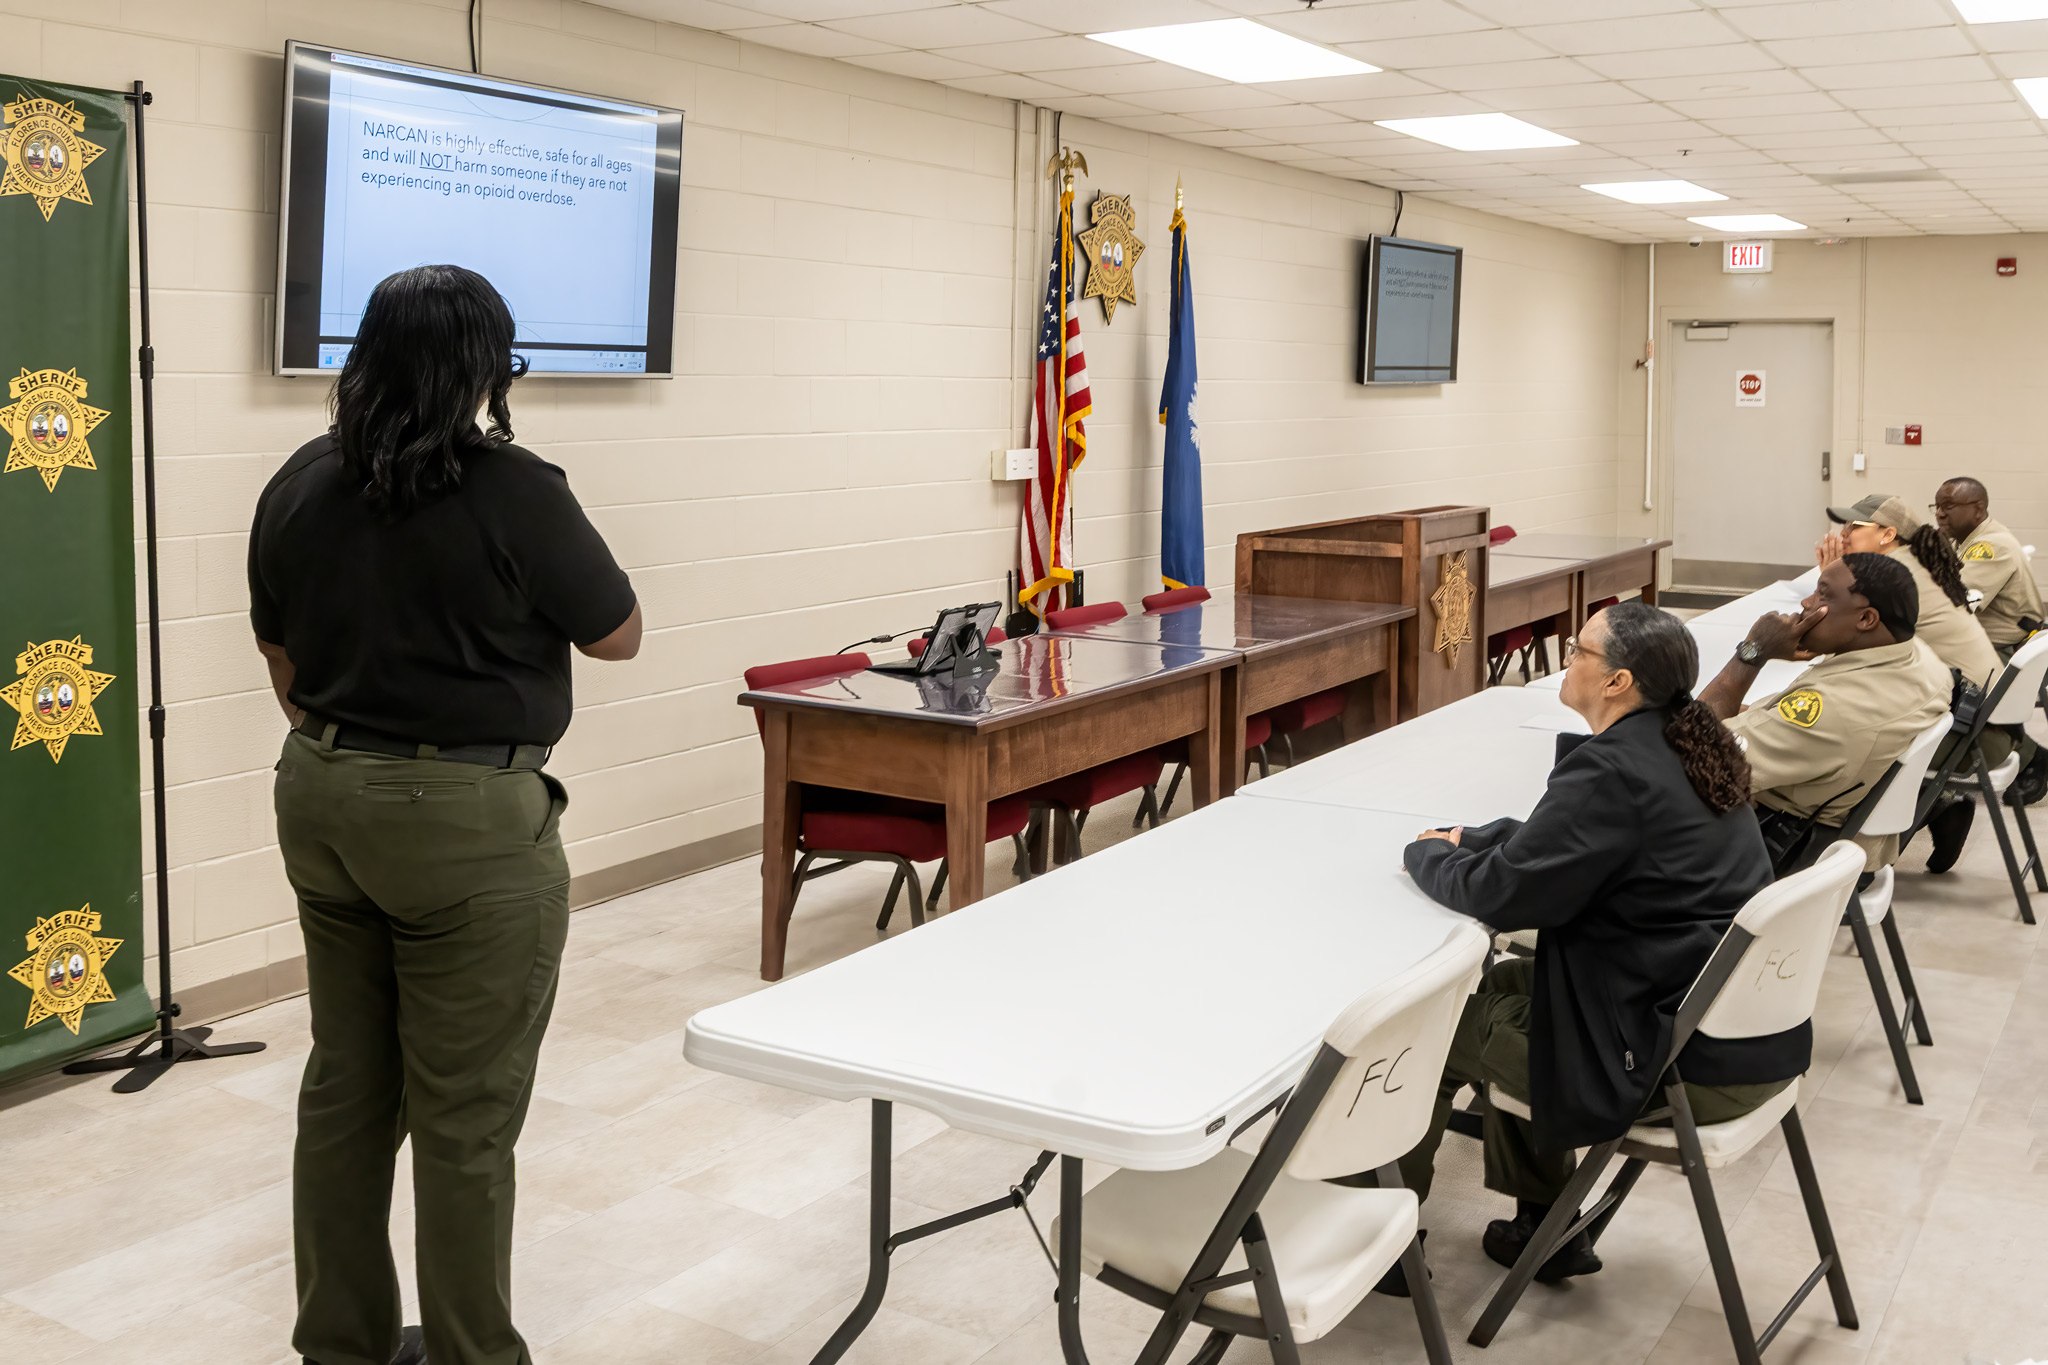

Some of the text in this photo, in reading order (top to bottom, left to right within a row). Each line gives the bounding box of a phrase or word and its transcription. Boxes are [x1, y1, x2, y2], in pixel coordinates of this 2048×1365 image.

[13, 101, 78, 126] SHERIFF
[11, 119, 78, 153] FLORENCE COUNTY
[363, 121, 632, 174] NARCAN is highly effective, safe for all ages
[13, 163, 77, 194] SHERIFF'S OFFICE
[362, 147, 627, 192] and will NOT harm someone if they are not
[361, 172, 576, 206] experiencing an opioid overdose.
[1096, 199, 1132, 222] SHERIFF
[1732, 246, 1762, 266] EXIT
[18, 372, 81, 393] SHERIFF
[1740, 380, 1761, 390] STOP
[17, 390, 81, 421] FLORENCE COUNTY
[18, 435, 81, 464] SHERIFF'S OFFICE
[25, 643, 87, 667] SHERIFF
[24, 660, 87, 696] FLORENCE COUNTY
[25, 703, 86, 735] SHERIFF'S OFFICE
[35, 914, 95, 943] SHERIFF
[36, 931, 96, 972] FLORENCE COUNTY
[1753, 949, 1800, 989] FC
[1347, 1046, 1412, 1119] FC
